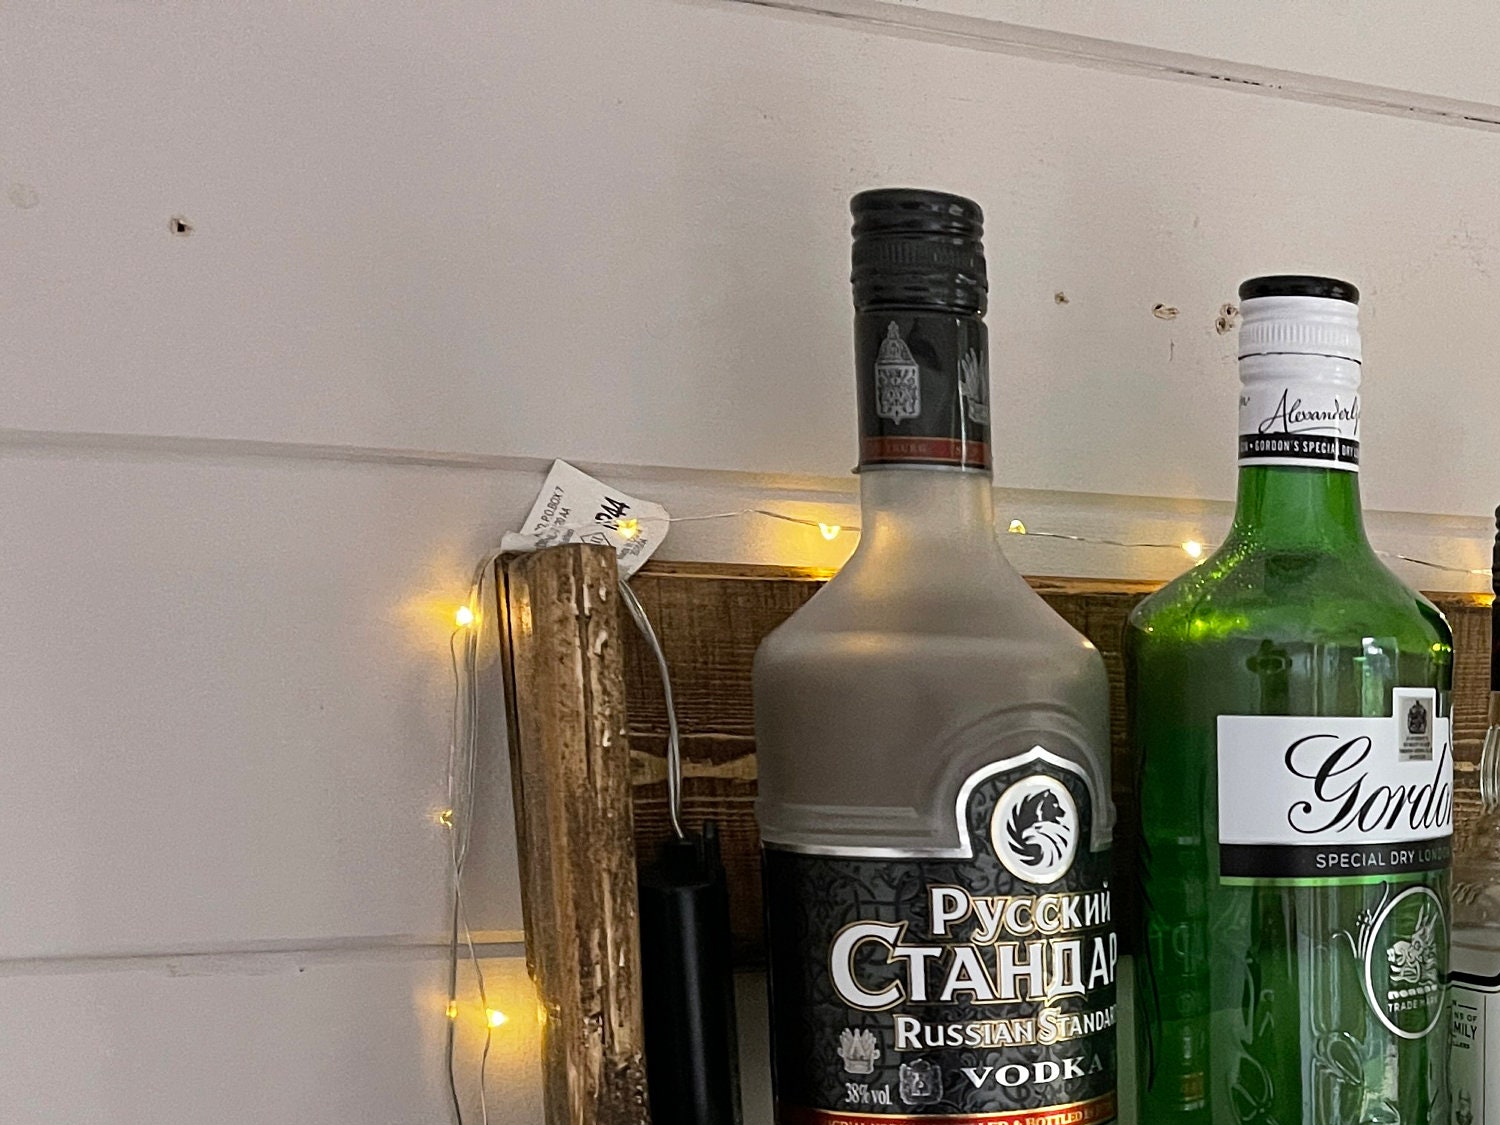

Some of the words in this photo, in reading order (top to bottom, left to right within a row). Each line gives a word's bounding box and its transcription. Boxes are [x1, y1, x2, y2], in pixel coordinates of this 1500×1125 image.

[1254, 439, 1300, 453] GORDON'S
[1302, 441, 1338, 455] SPECIA
[1316, 851, 1387, 869] SPECIAL
[1390, 850, 1416, 866] DRY
[1387, 998, 1419, 1013] TRADE
[894, 1014, 1033, 1051] RUSSIAN
[1453, 1021, 1478, 1041] MILY
[961, 1056, 1104, 1088] VODKA
[845, 1082, 870, 1104] 38%
[871, 1084, 893, 1105] vol
